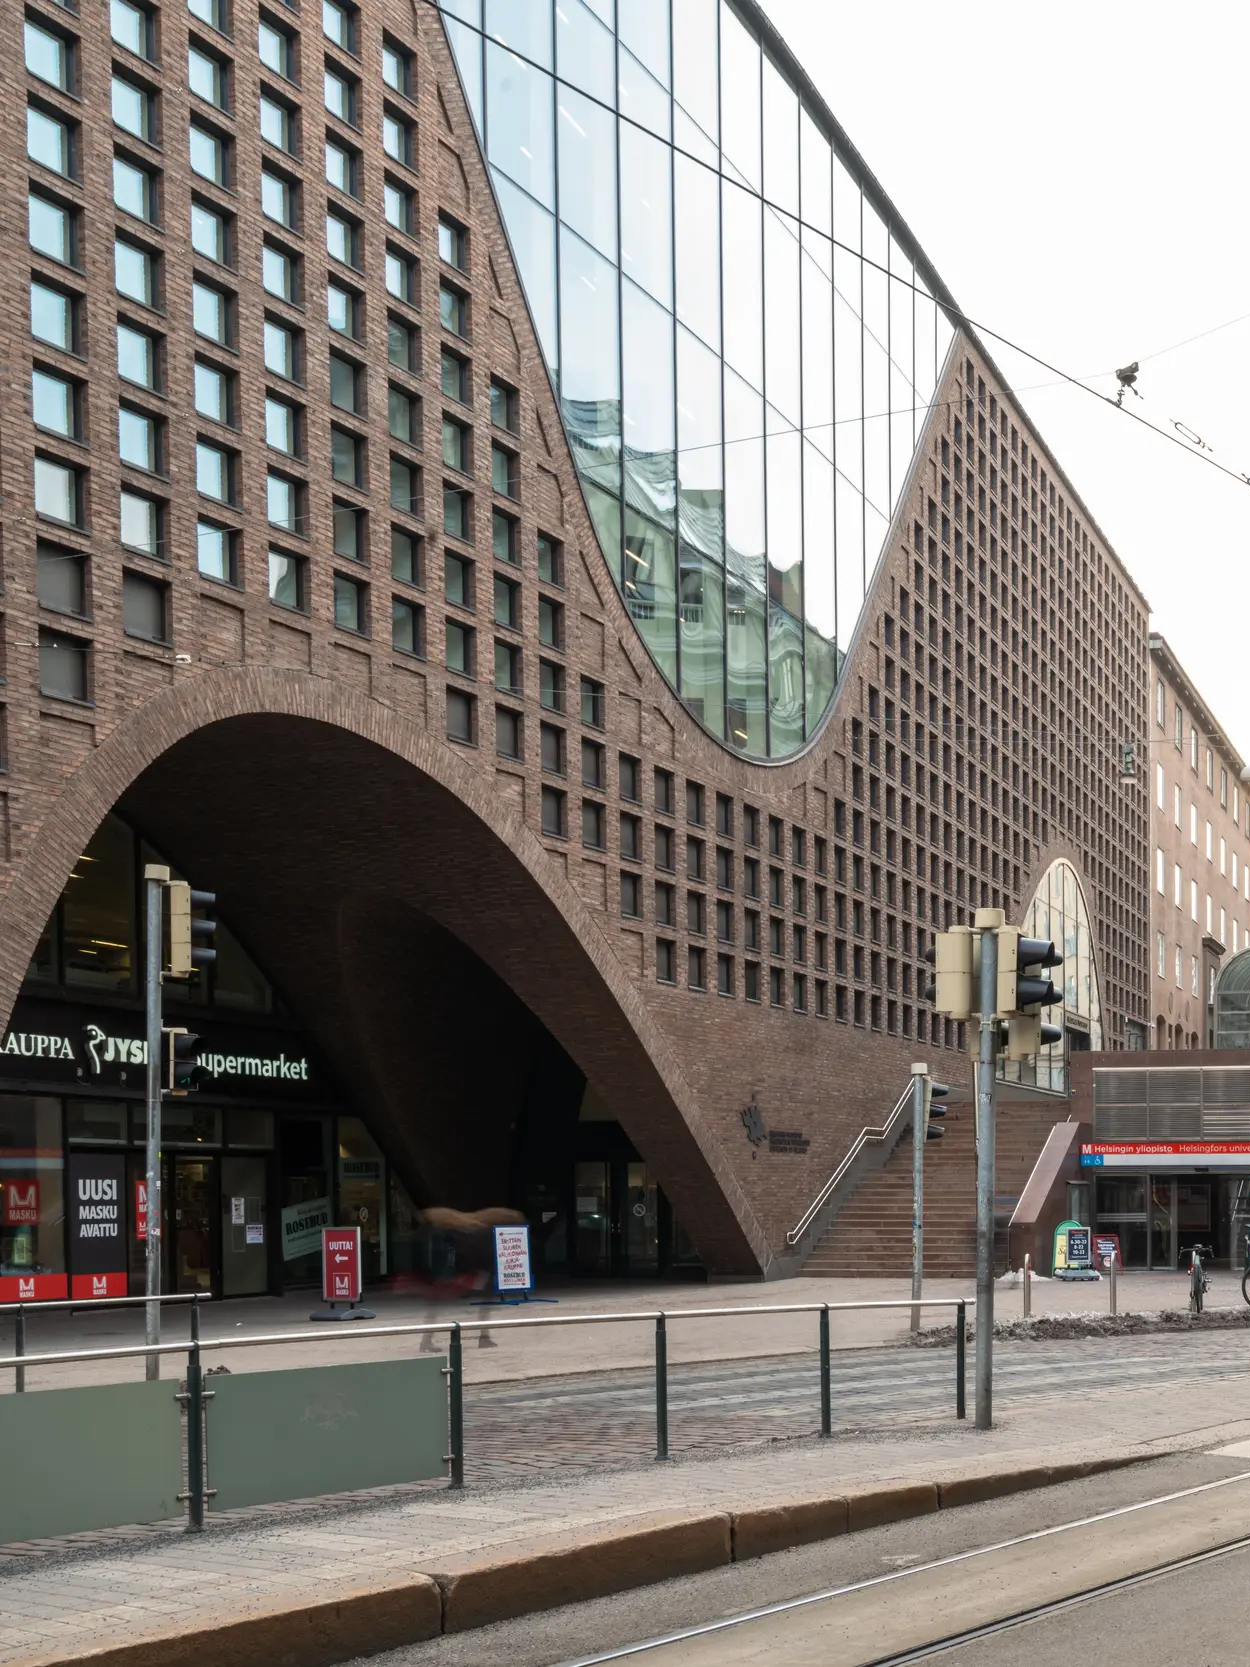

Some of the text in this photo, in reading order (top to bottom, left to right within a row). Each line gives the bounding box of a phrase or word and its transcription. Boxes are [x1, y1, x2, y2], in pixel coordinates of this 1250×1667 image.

[104, 1036, 148, 1065] JYS
[196, 1052, 308, 1080] upermarket
[1082, 1144, 1092, 1154] M
[1094, 1145, 1134, 1154] Helsingin
[1136, 1145, 1173, 1154] yliopisto
[1179, 1144, 1227, 1153] Helsingfors
[78, 1179, 118, 1201] UUSI
[9, 1210, 37, 1221] MASKU
[79, 1205, 118, 1220] MASKU
[79, 1223, 119, 1238] AVATTU
[285, 1212, 328, 1235] ROSEBUD
[329, 1241, 353, 1251] UUTTA!
